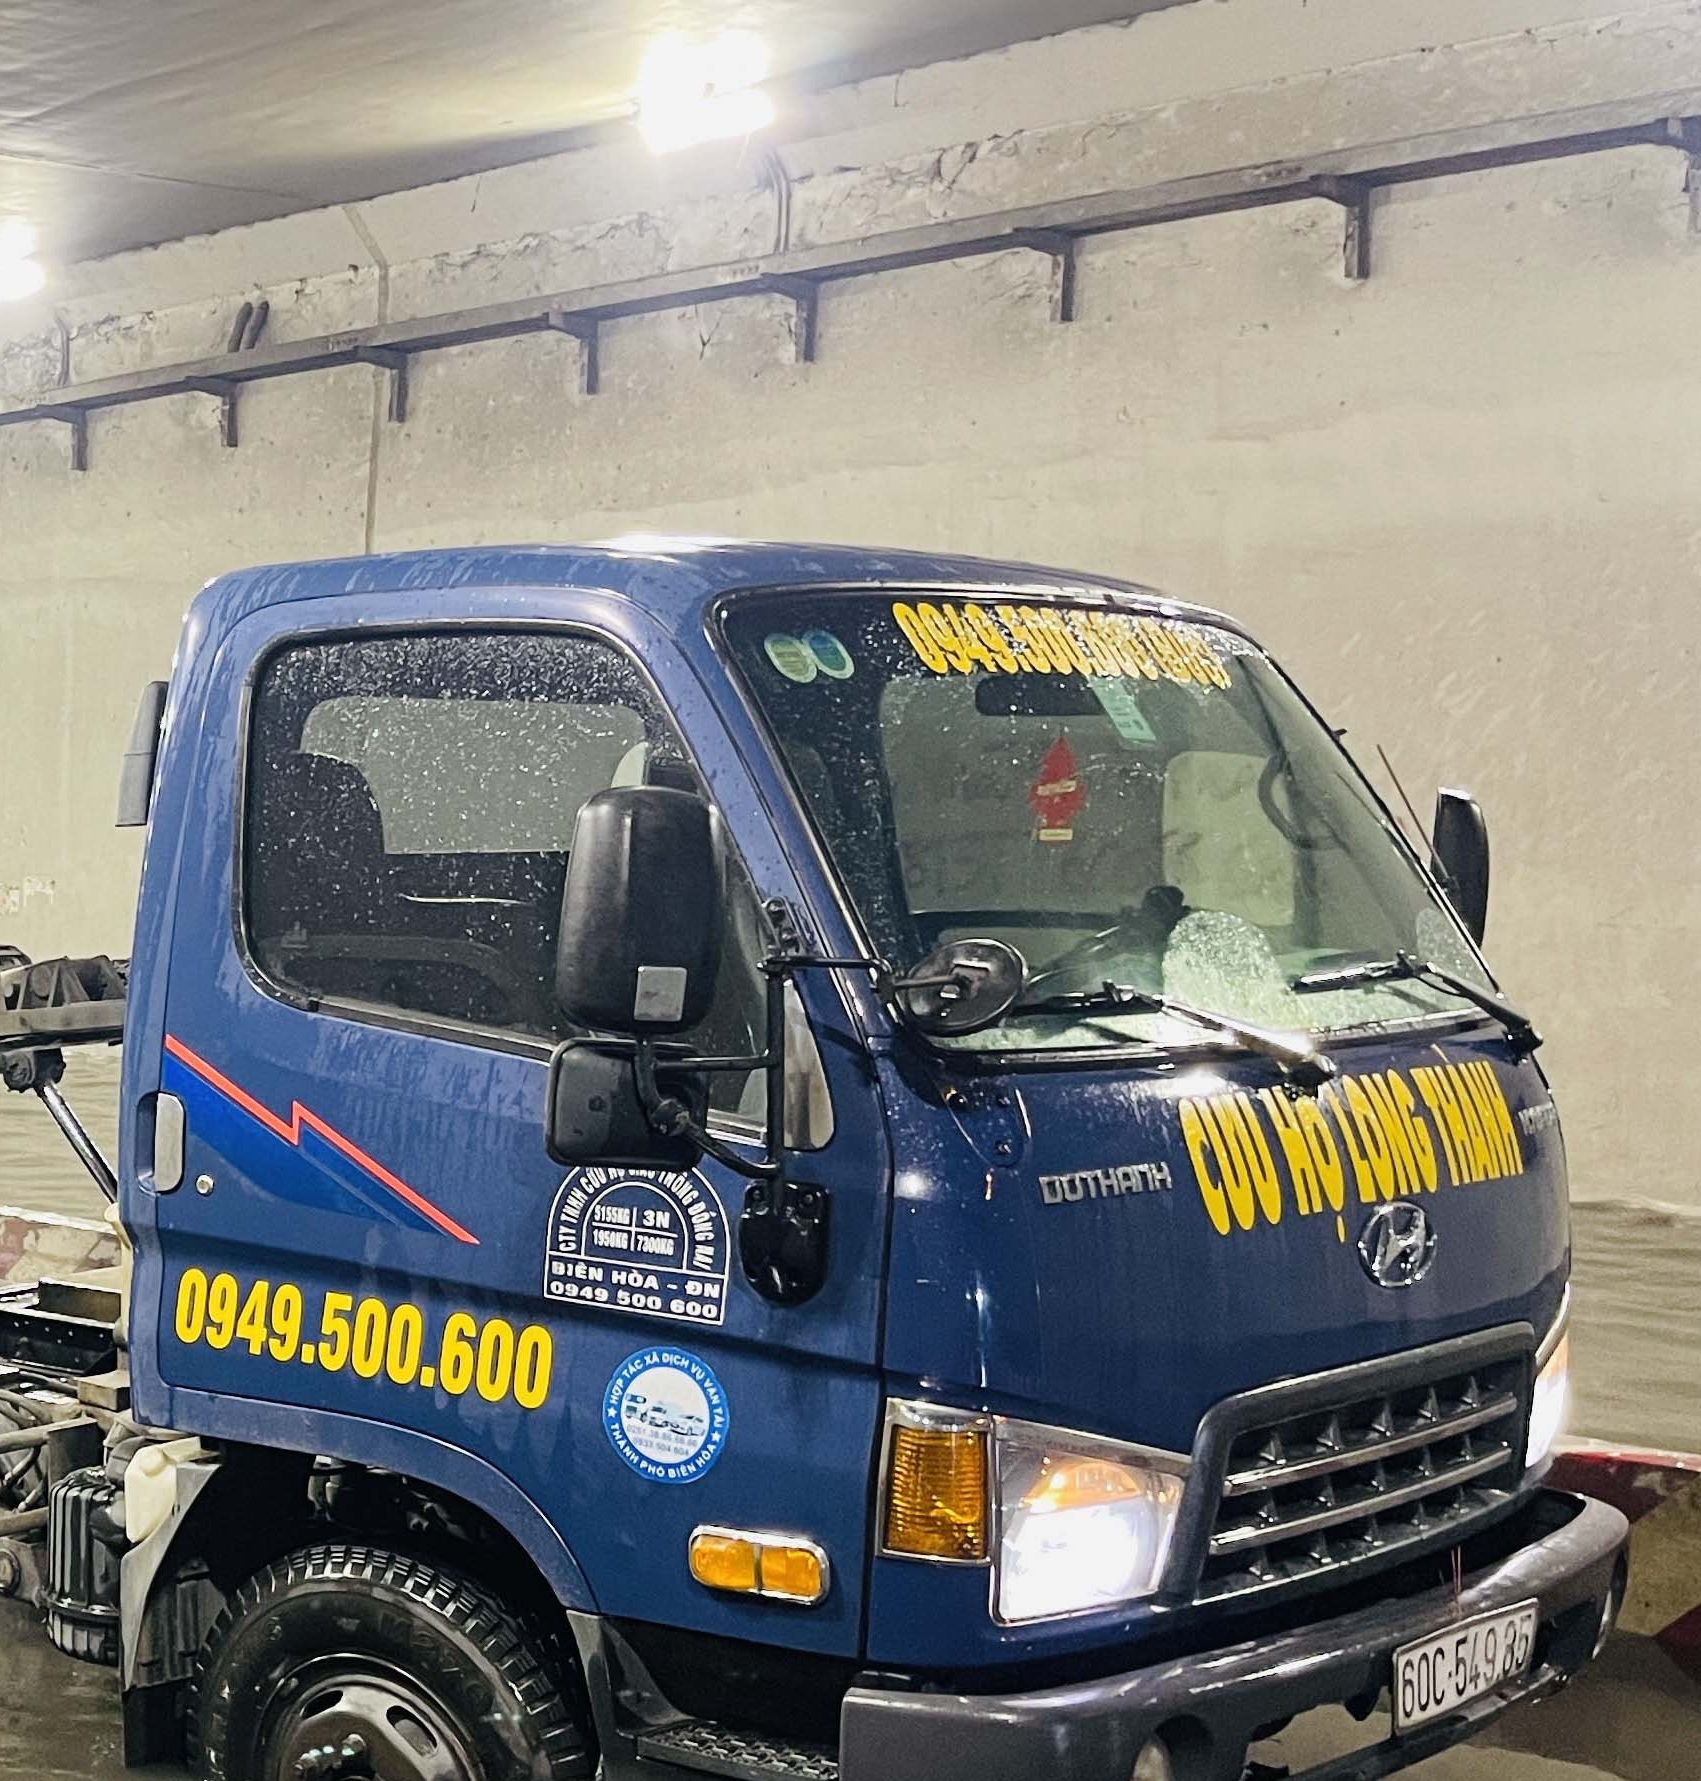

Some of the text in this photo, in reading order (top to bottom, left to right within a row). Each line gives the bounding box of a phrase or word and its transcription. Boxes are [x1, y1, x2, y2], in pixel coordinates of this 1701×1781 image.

[1319, 1068, 1437, 1203] LONG
[1409, 1044, 1523, 1187] THÀNH
[560, 1187, 588, 1224] TNHH
[643, 1210, 670, 1229] 3N
[559, 1225, 576, 1251] CTY
[593, 1229, 629, 1250] 1950KG
[693, 1244, 714, 1270] NAI
[551, 1261, 604, 1282] BIÊN
[550, 1281, 718, 1319] 0949 500 600
[174, 1268, 553, 1410] 0949.500.600
